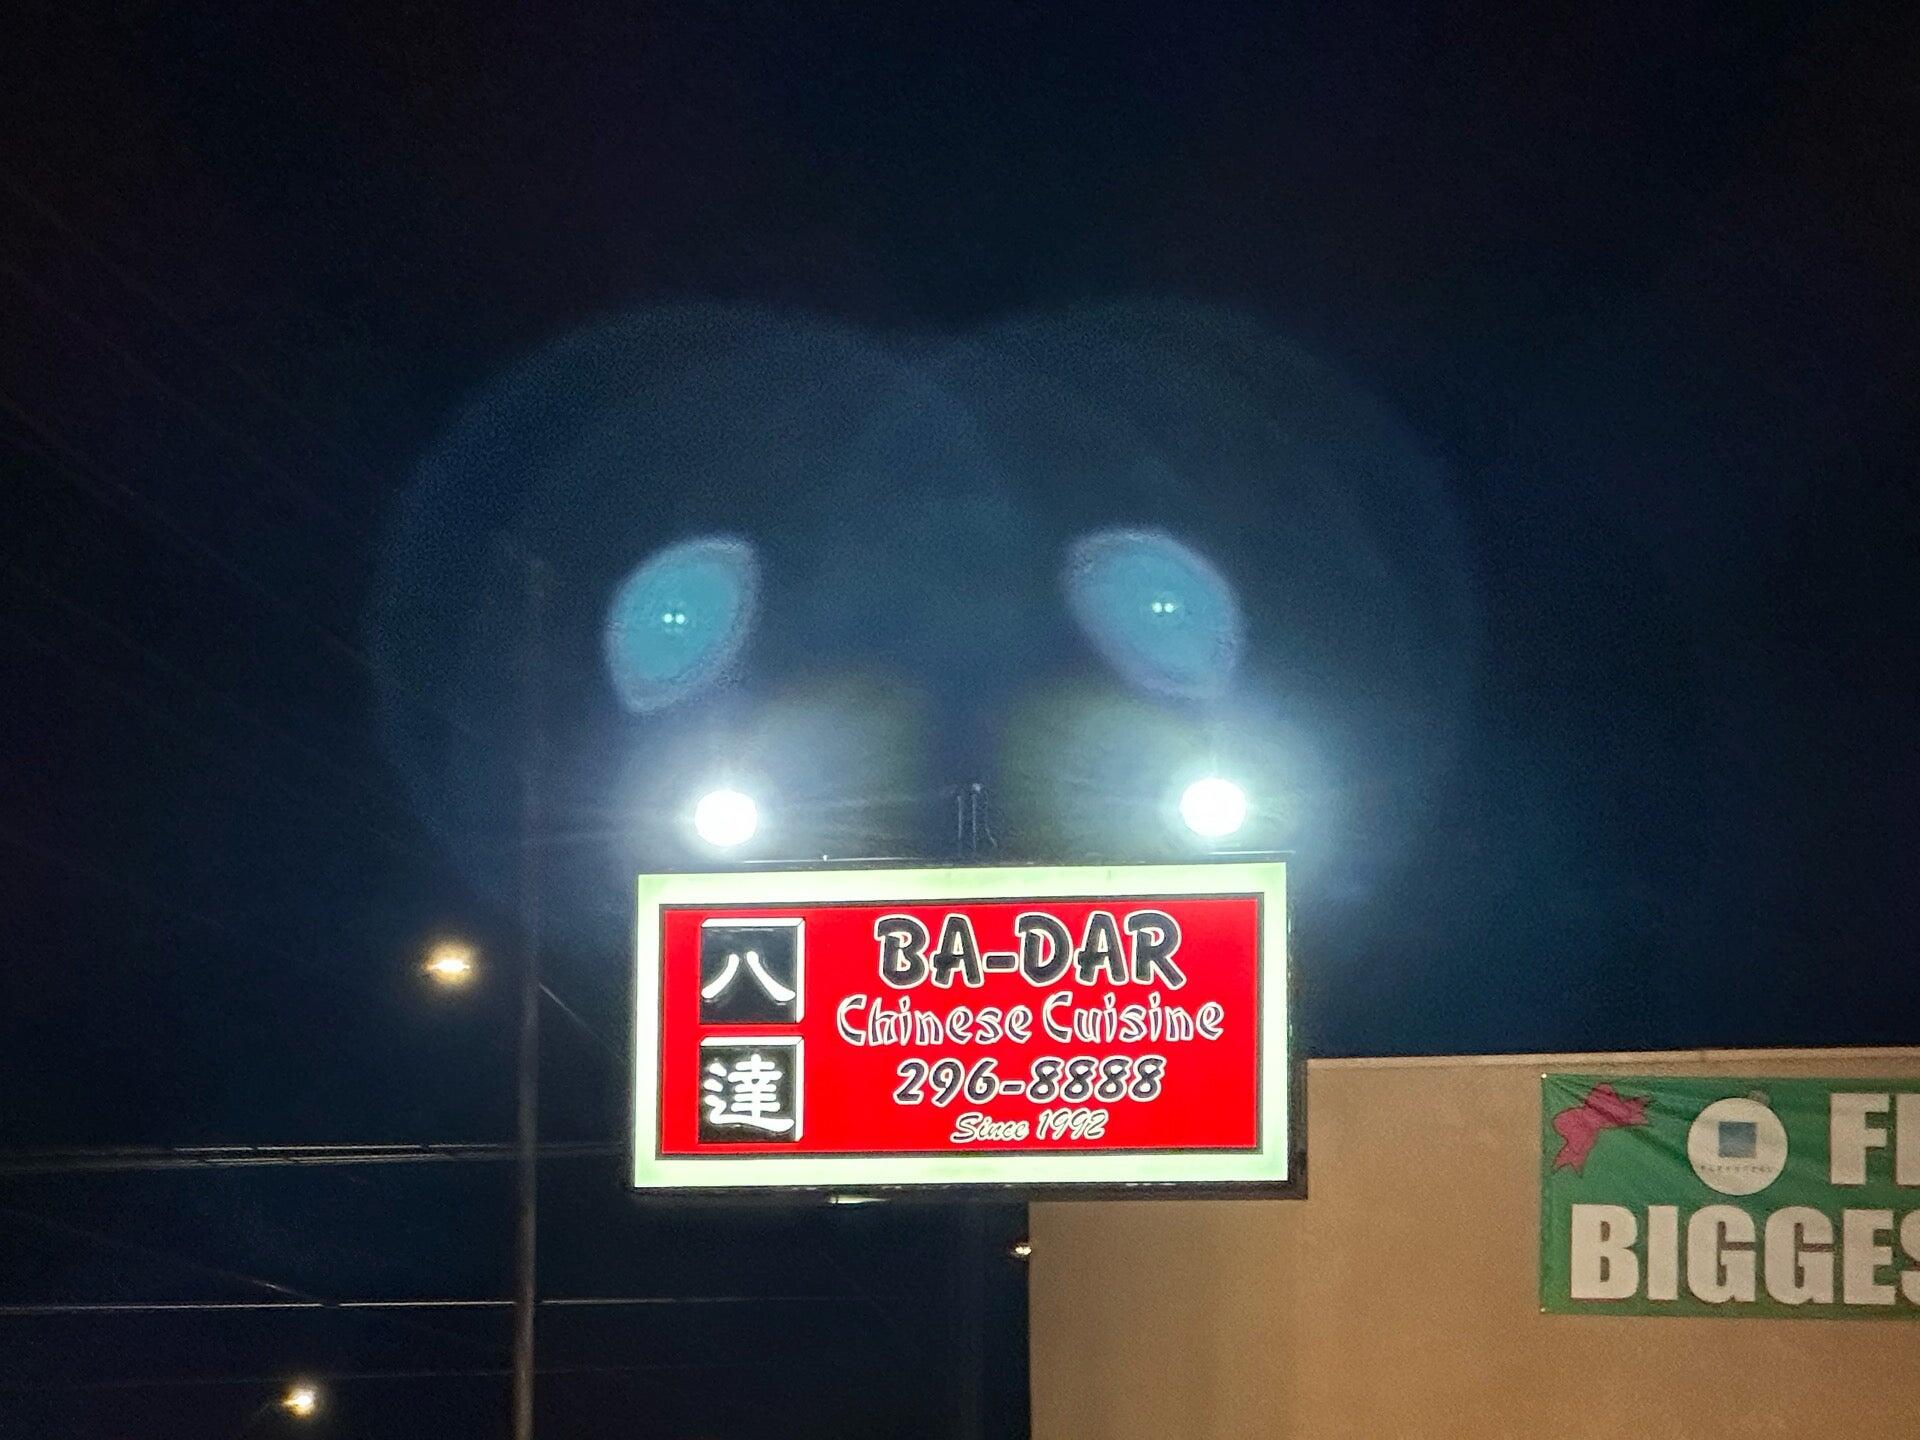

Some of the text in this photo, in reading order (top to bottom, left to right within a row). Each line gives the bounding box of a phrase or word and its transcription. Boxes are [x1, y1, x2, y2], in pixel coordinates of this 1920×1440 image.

[875, 911, 1187, 990] BA-DAR
[836, 991, 1225, 1047] Chinese Cuisine
[892, 1056, 1167, 1107] 296-8888
[950, 1108, 1107, 1145] Since 1992
